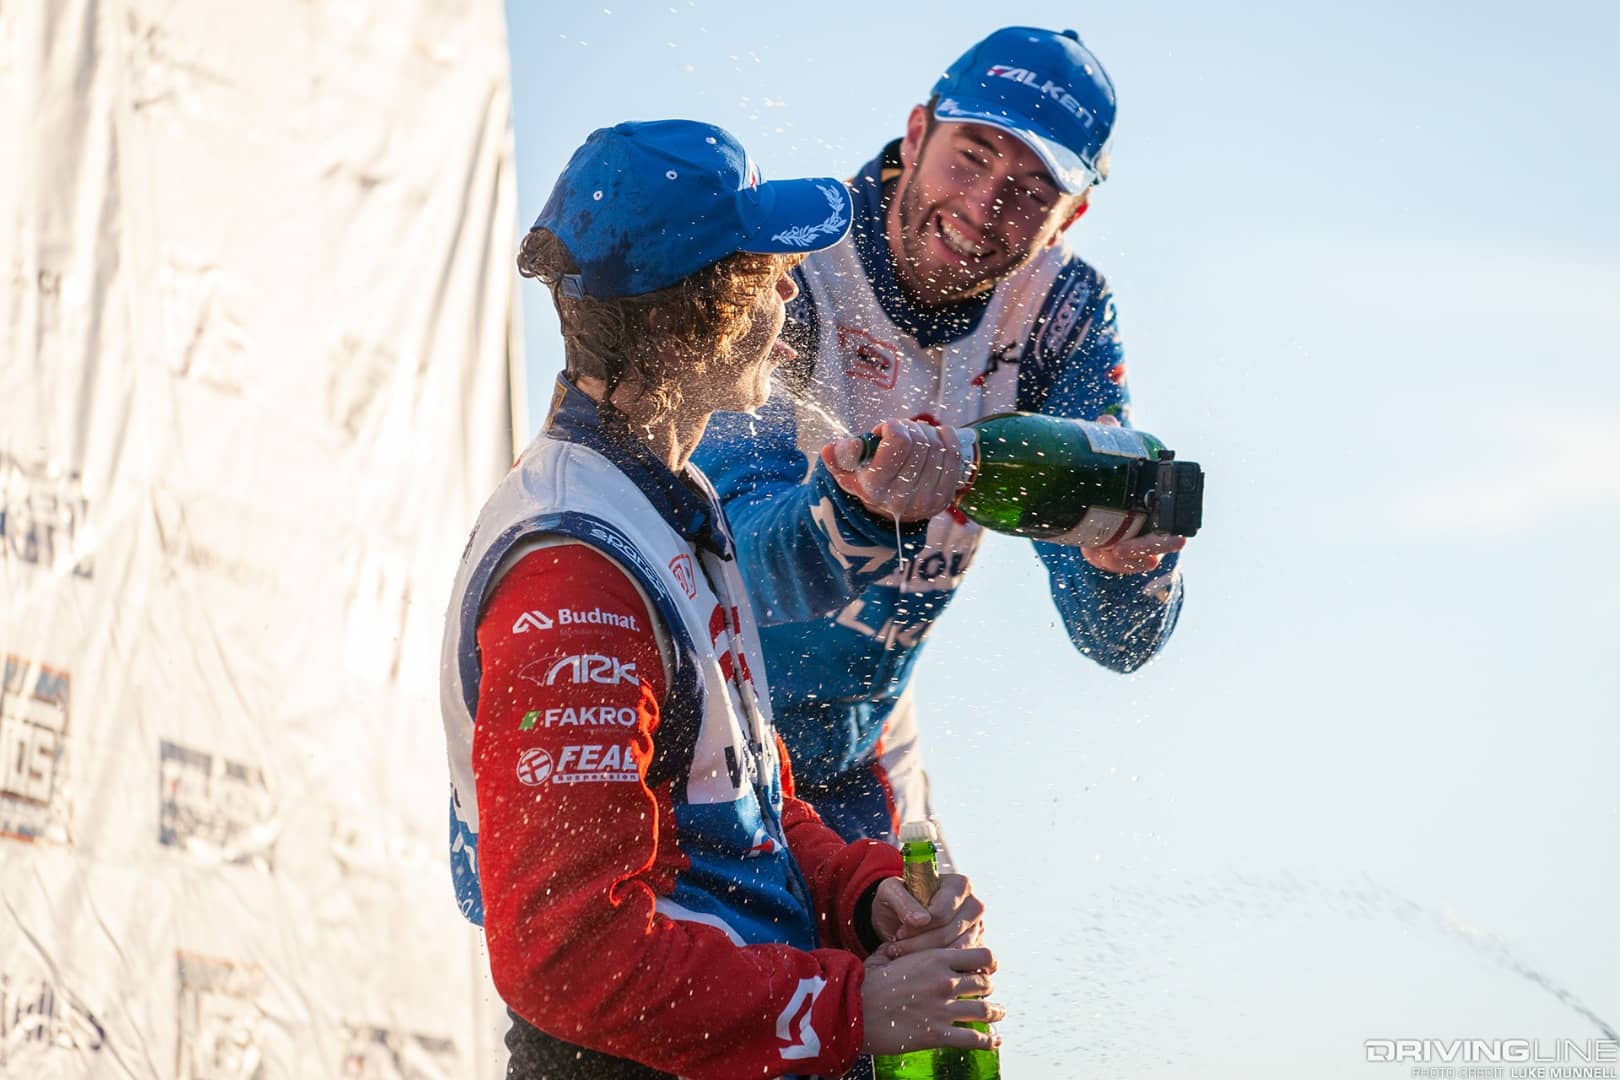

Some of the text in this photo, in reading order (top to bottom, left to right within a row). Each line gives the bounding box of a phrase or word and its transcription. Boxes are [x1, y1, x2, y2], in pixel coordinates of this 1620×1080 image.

[987, 64, 1093, 128] FALKEN
[544, 706, 637, 728] FAKRO
[556, 744, 638, 772] FEAL
